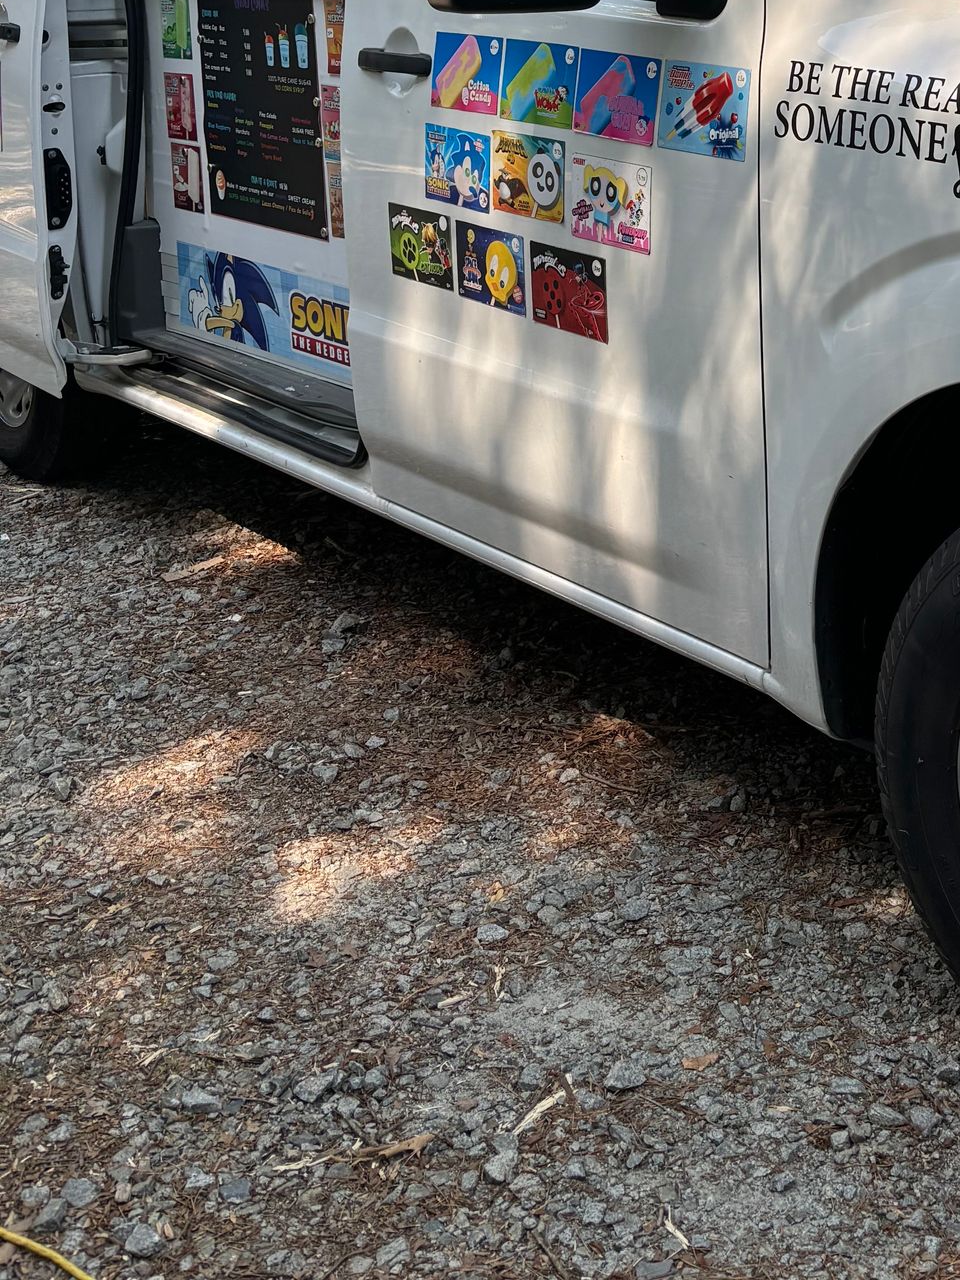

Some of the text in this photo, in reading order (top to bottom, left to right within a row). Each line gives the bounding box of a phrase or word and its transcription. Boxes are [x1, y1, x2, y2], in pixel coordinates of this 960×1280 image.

[468, 79, 490, 91] Cotton
[786, 60, 824, 95] BE
[831, 64, 895, 104] THE
[469, 91, 492, 106] Candy
[709, 128, 739, 143] Original
[774, 100, 948, 164] SOMEONE
[427, 175, 450, 190] SONIC
[290, 292, 350, 346] SONI
[293, 335, 350, 363] THE HEDGE
